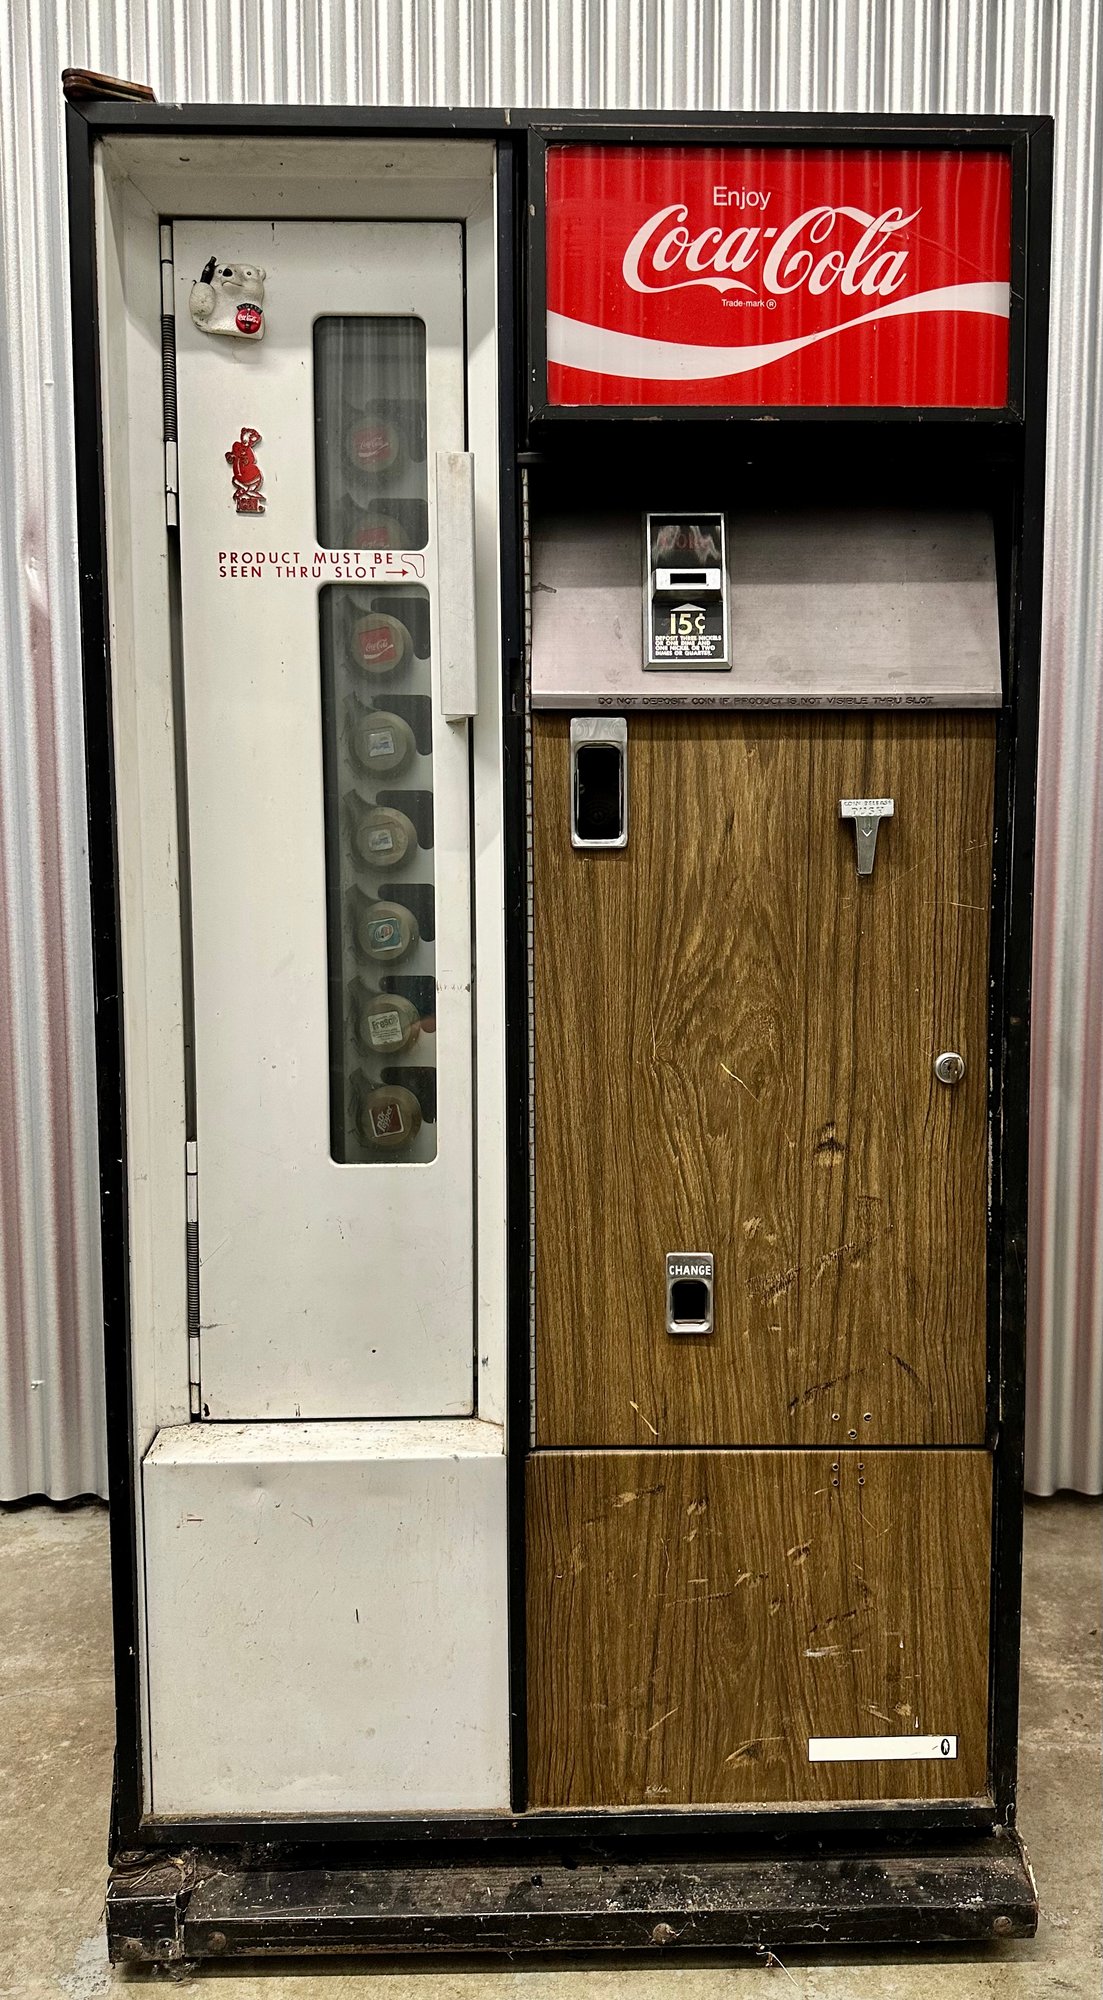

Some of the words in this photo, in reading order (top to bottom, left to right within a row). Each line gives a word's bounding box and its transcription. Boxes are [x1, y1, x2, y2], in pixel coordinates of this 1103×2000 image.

[713, 186, 771, 211] Enjoy
[622, 203, 922, 296] Coca-Cola
[218, 552, 300, 564] PRODUCT
[313, 552, 361, 564] MUST
[374, 553, 393, 564] BE
[218, 566, 262, 577] SEEN
[276, 566, 322, 578] THRU
[335, 566, 377, 578] SLOT
[670, 613, 706, 635] 15¢
[598, 697, 613, 705] DO
[617, 697, 638, 705] NOT
[642, 697, 688, 705] DEPOSIT
[691, 697, 715, 705] COIN
[720, 697, 730, 705] IF
[734, 697, 783, 705] PRODUCT
[787, 697, 797, 705] IS
[669, 1265, 712, 1276] CHANGE
